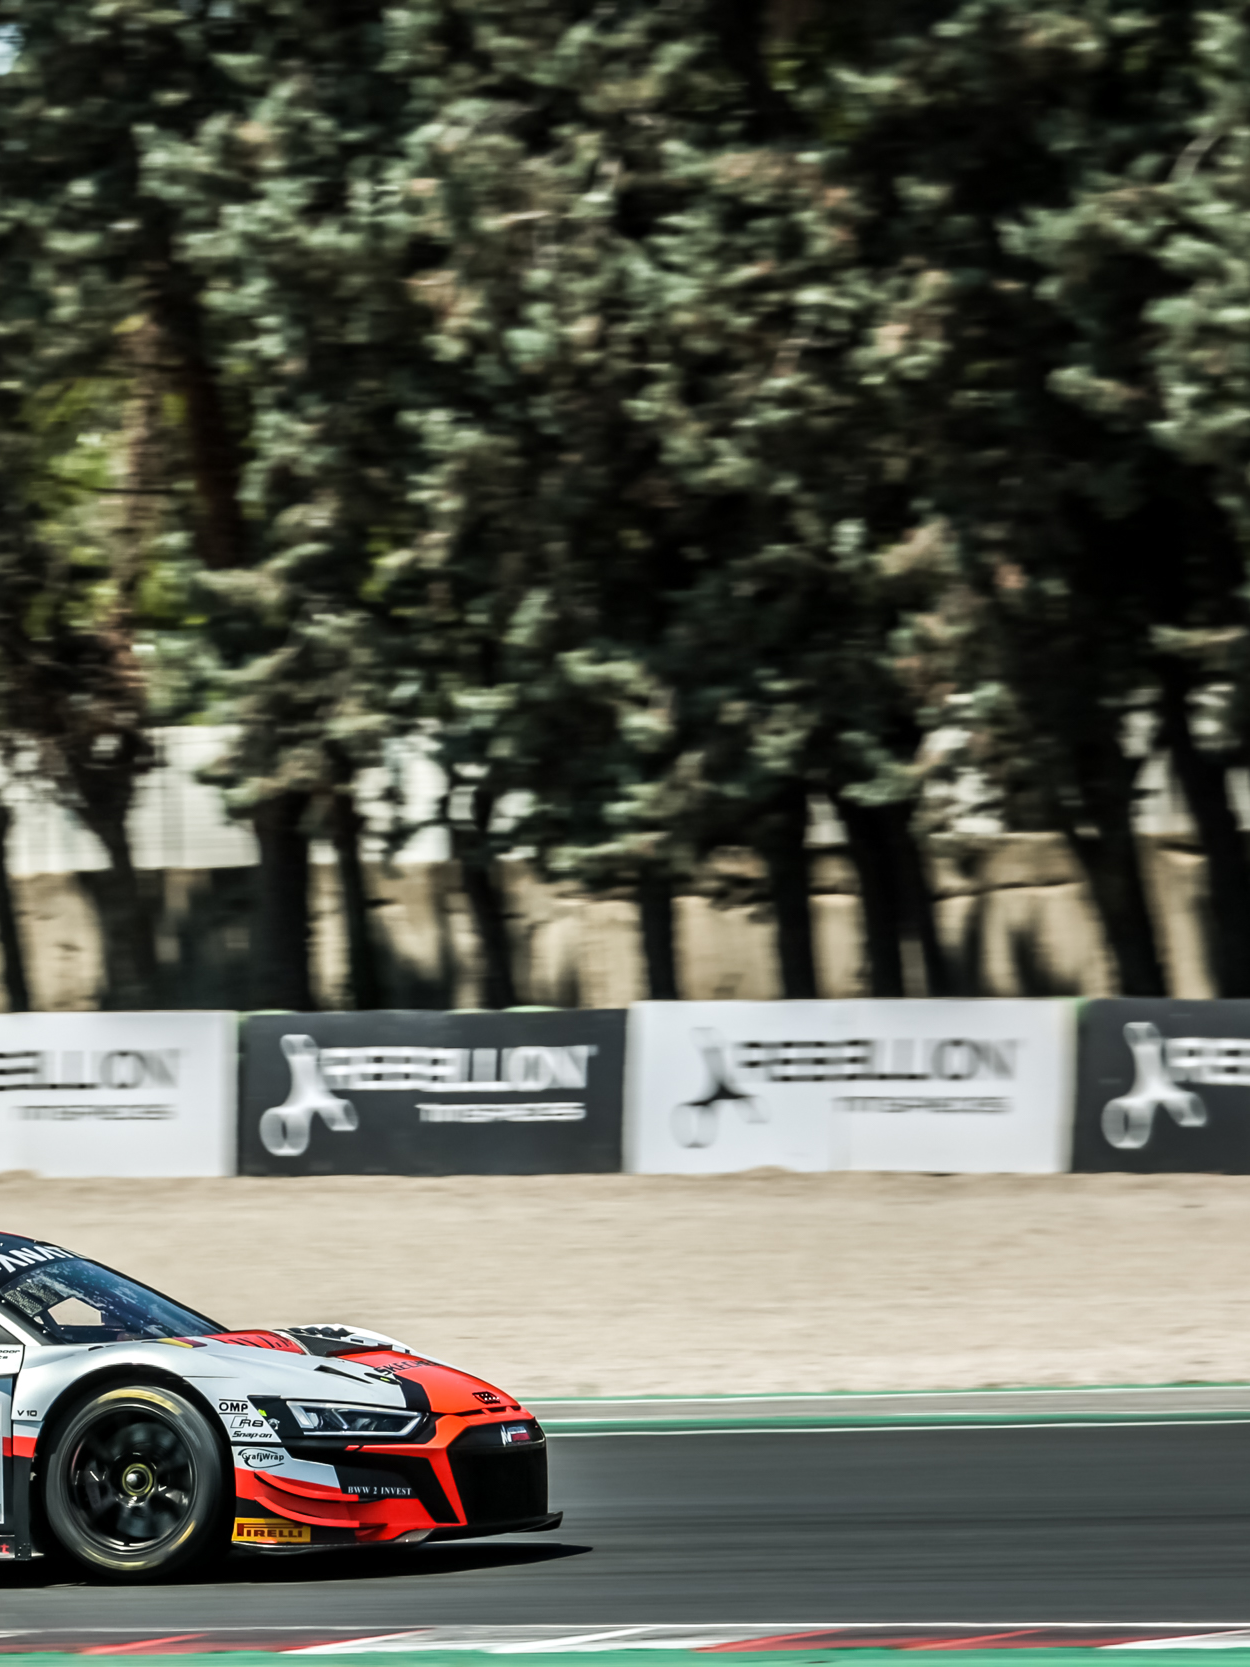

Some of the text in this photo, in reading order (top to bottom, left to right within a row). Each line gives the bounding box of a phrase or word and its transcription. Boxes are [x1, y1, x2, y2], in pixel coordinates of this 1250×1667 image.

[741, 1038, 1016, 1083] REBELLION
[321, 1046, 588, 1091] REBELLION
[218, 1401, 248, 1413] OMP
[235, 1417, 264, 1428] R8
[232, 1431, 273, 1439] Snap-on
[241, 1452, 285, 1462] GrafiWrap
[347, 1486, 412, 1496] BWW 2 INVEST
[237, 1523, 304, 1538] PIRELLI
